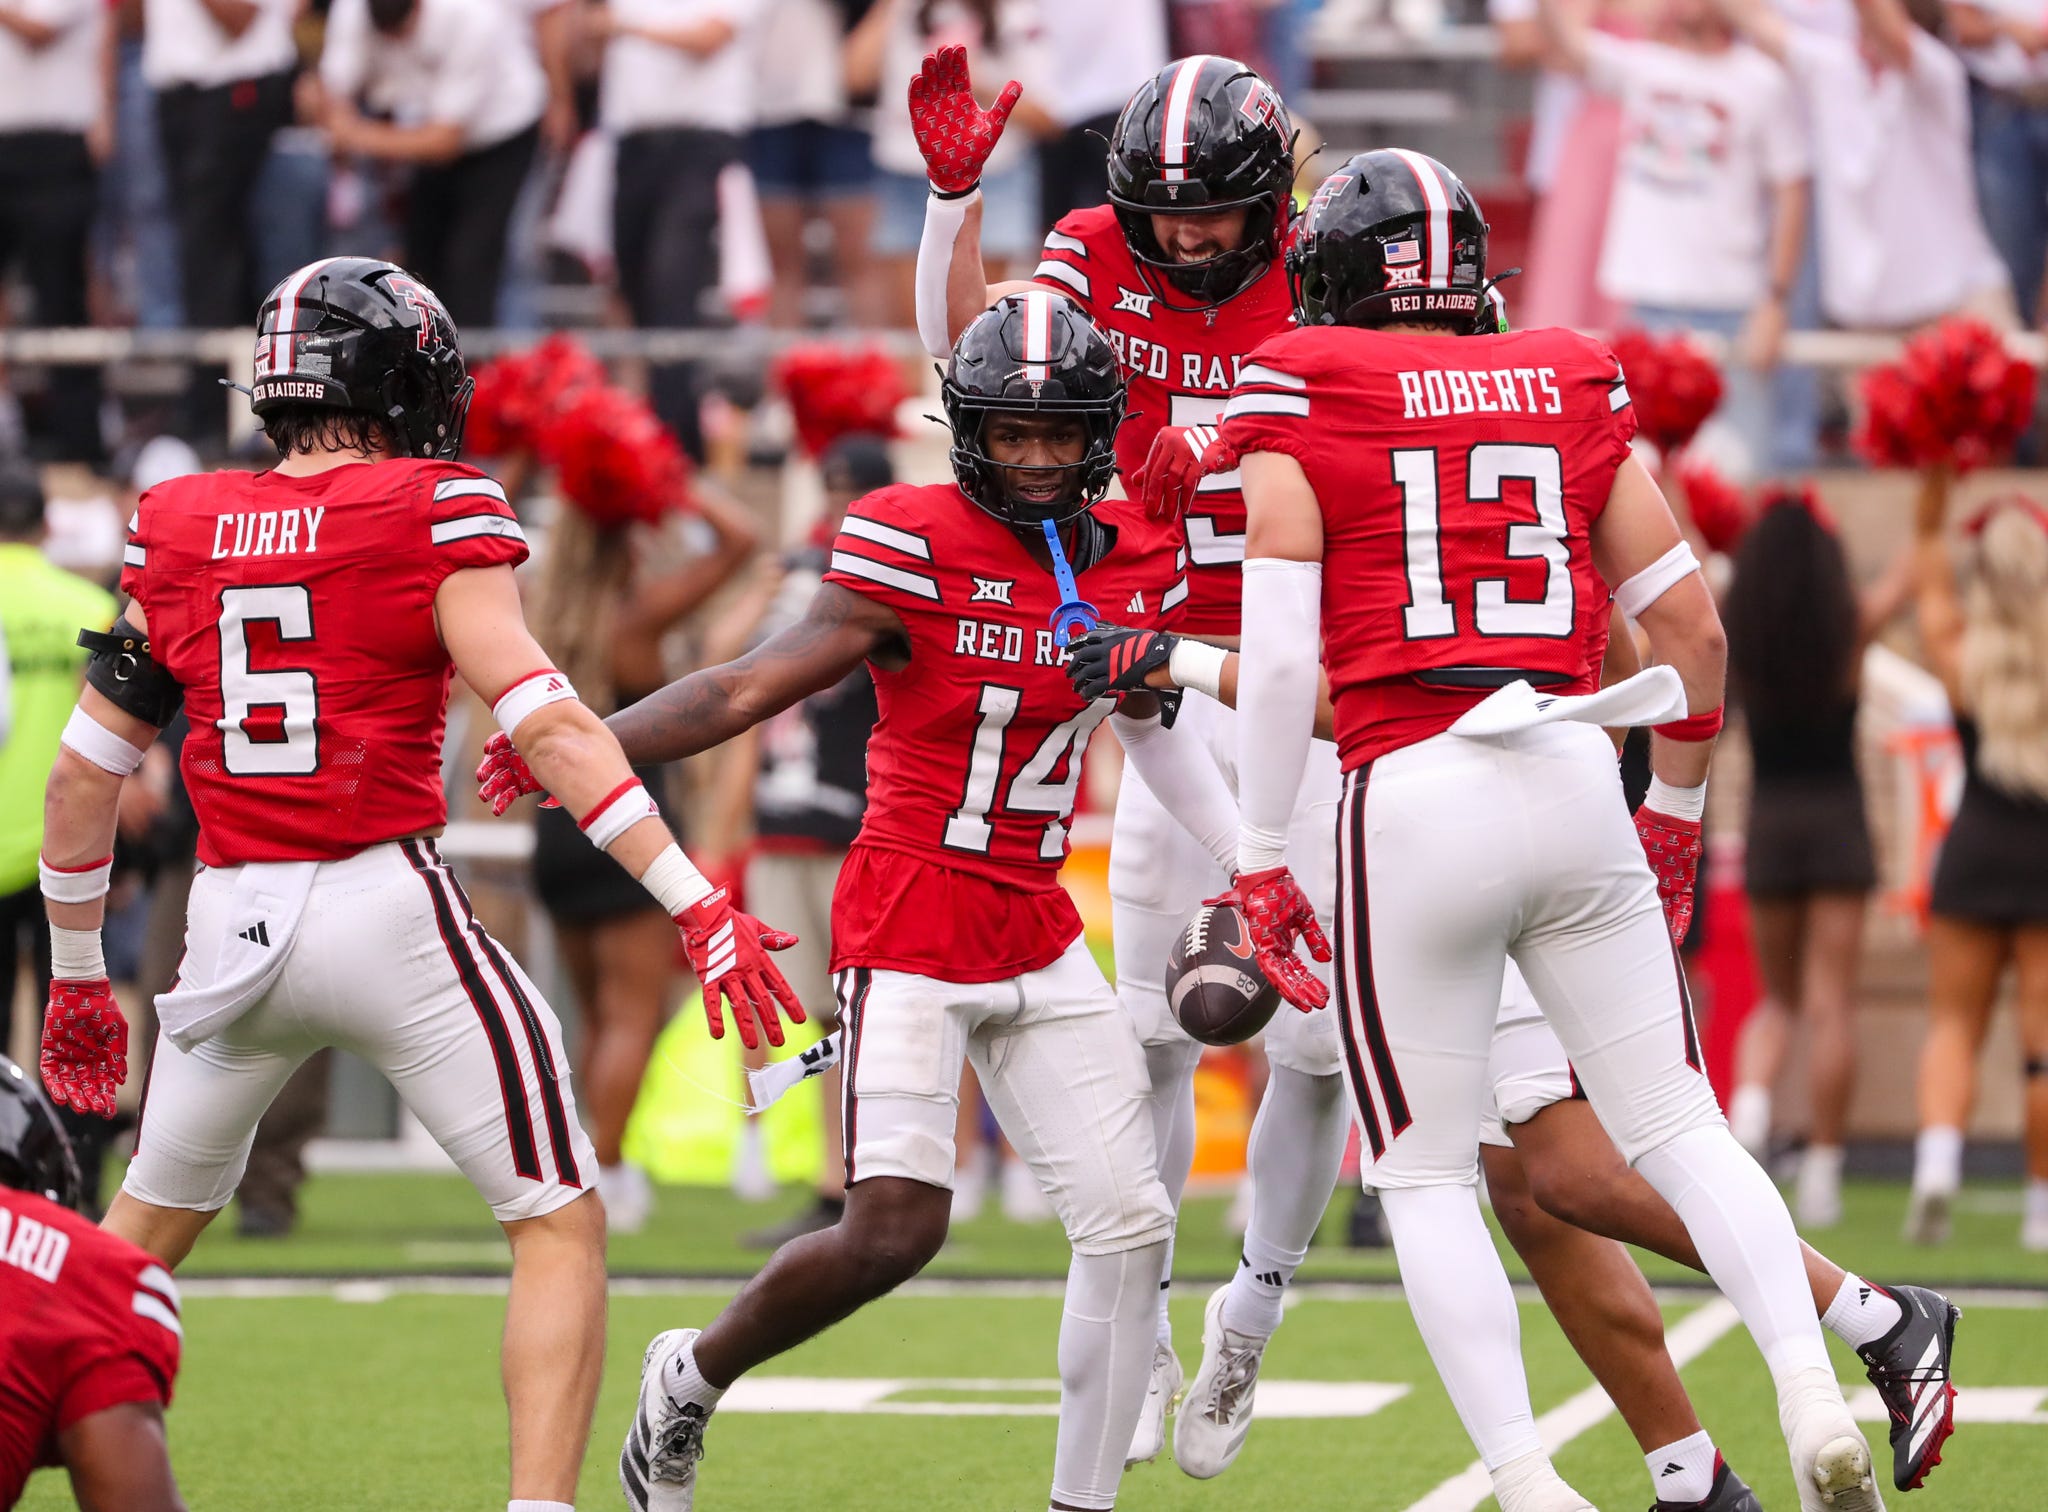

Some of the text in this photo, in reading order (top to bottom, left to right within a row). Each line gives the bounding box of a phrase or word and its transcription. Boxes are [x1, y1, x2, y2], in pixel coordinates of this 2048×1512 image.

[1112, 285, 1154, 319] XII
[1390, 294, 1478, 312] RED RAIDERS
[1108, 327, 1169, 381] RED
[267, 382, 325, 399] RAIDERS
[1397, 367, 1562, 419] ROBERTS
[211, 506, 325, 560] CURRY
[1390, 442, 1575, 640] 13
[970, 576, 1014, 606] XII
[955, 619, 1023, 662] RED
[215, 582, 321, 777] 6
[942, 682, 1119, 861] 14
